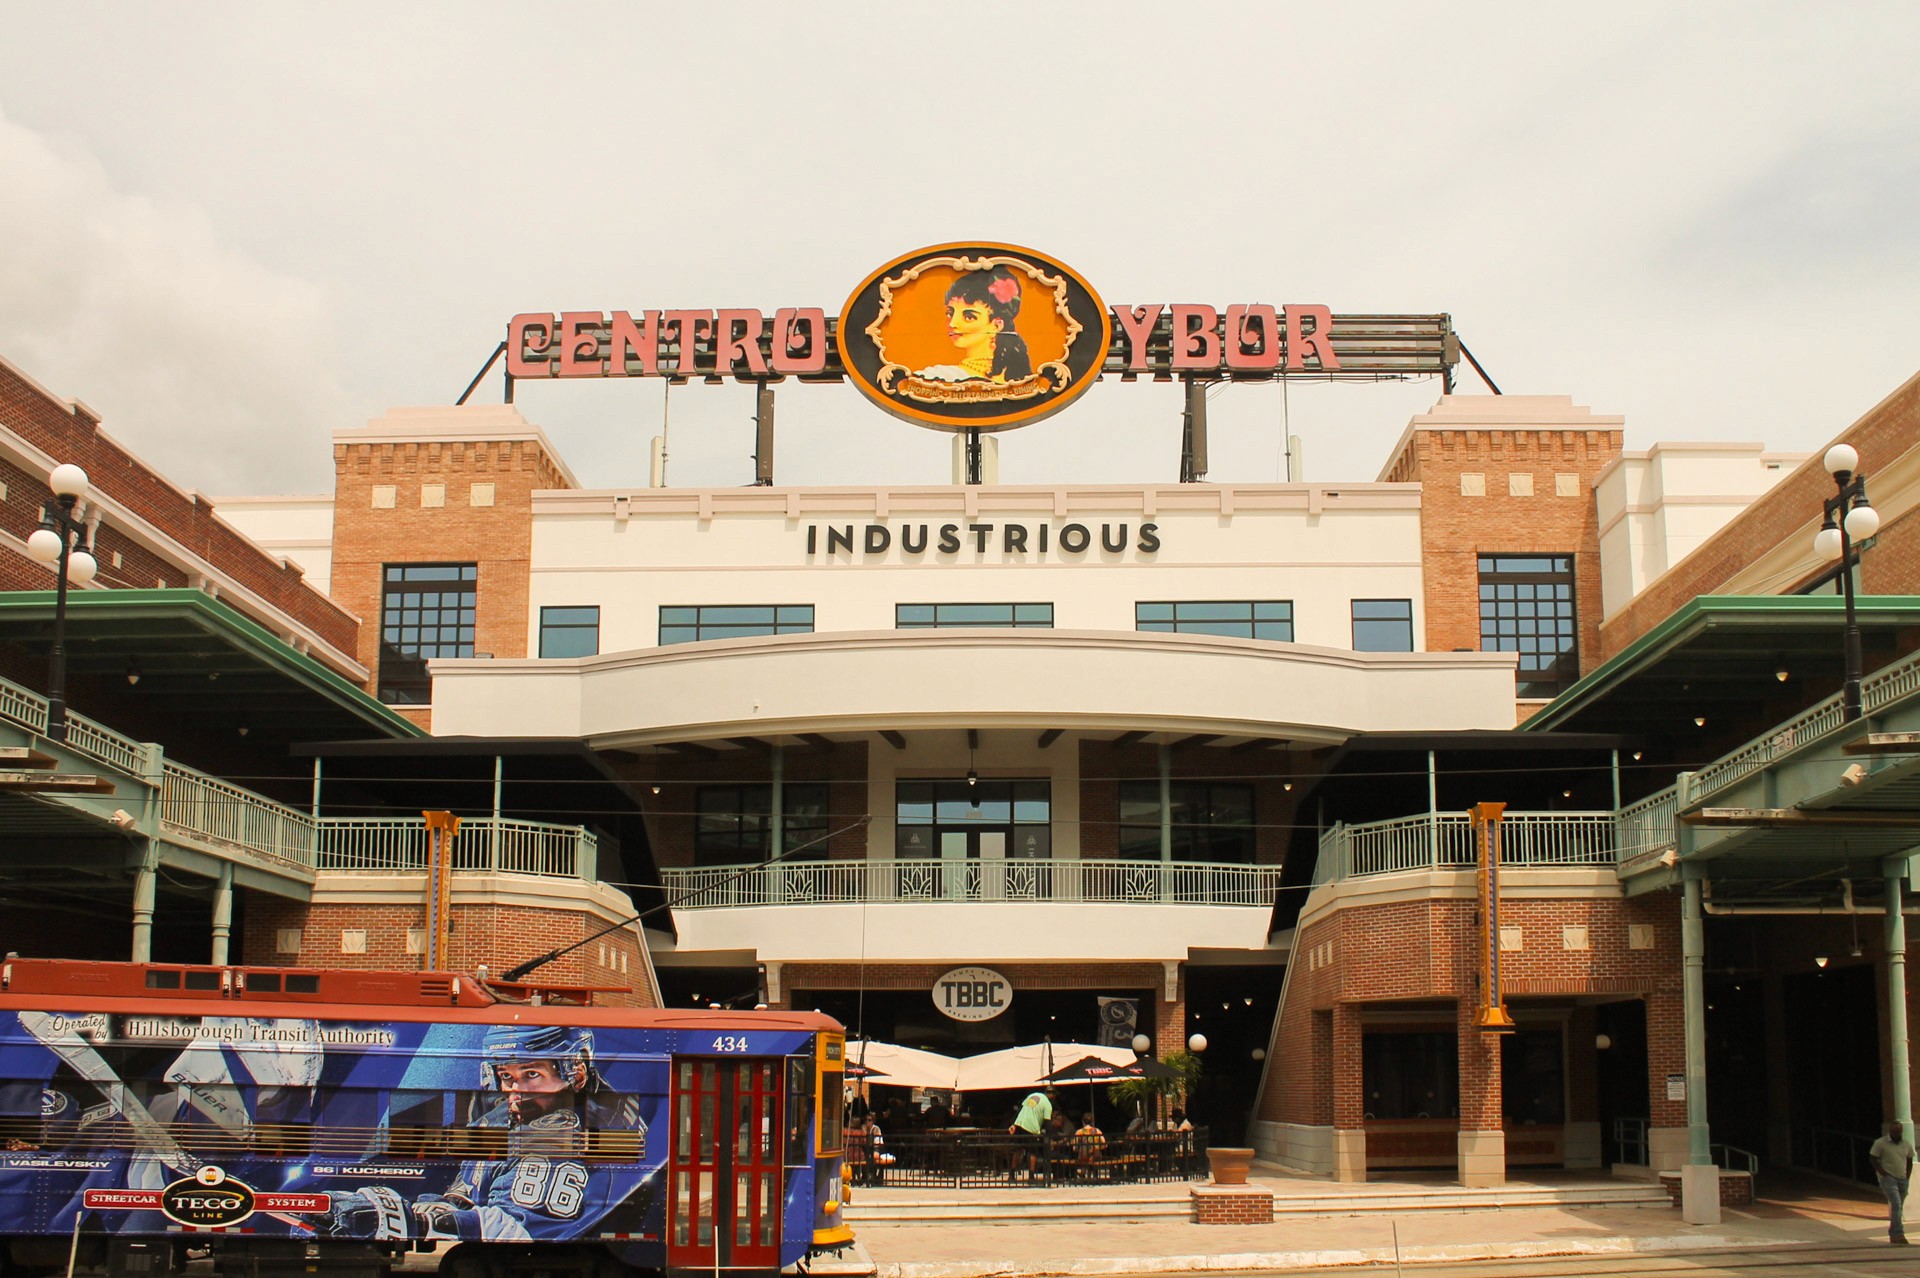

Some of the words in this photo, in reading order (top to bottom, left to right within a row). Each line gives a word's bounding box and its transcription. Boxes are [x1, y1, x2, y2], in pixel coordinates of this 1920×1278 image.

[507, 307, 827, 377] CENTRO
[1110, 303, 1342, 371] YBOR
[907, 385, 944, 397] SHOPPING
[949, 390, 1008, 399] ENTERTAINMENT
[1014, 383, 1038, 395] DINING
[807, 523, 1161, 555] INDUSTRIOUS
[941, 981, 1004, 1008] TBBC
[53, 1014, 106, 1035] Operated
[95, 1028, 109, 1040] by
[129, 1021, 243, 1042] Hillsborough
[250, 1024, 308, 1042] Transit
[317, 1028, 395, 1047] Authority
[712, 1036, 749, 1052] 434
[171, 1073, 227, 1113] BAUER
[9, 1160, 110, 1168] VASILEVSKIY
[313, 1166, 335, 1174] 86
[342, 1167, 425, 1175] KUCHEROV
[510, 1153, 590, 1218] 86
[91, 1194, 158, 1204] STREETCAR
[172, 1196, 241, 1211] TECO
[267, 1197, 316, 1207] SYSTEM
